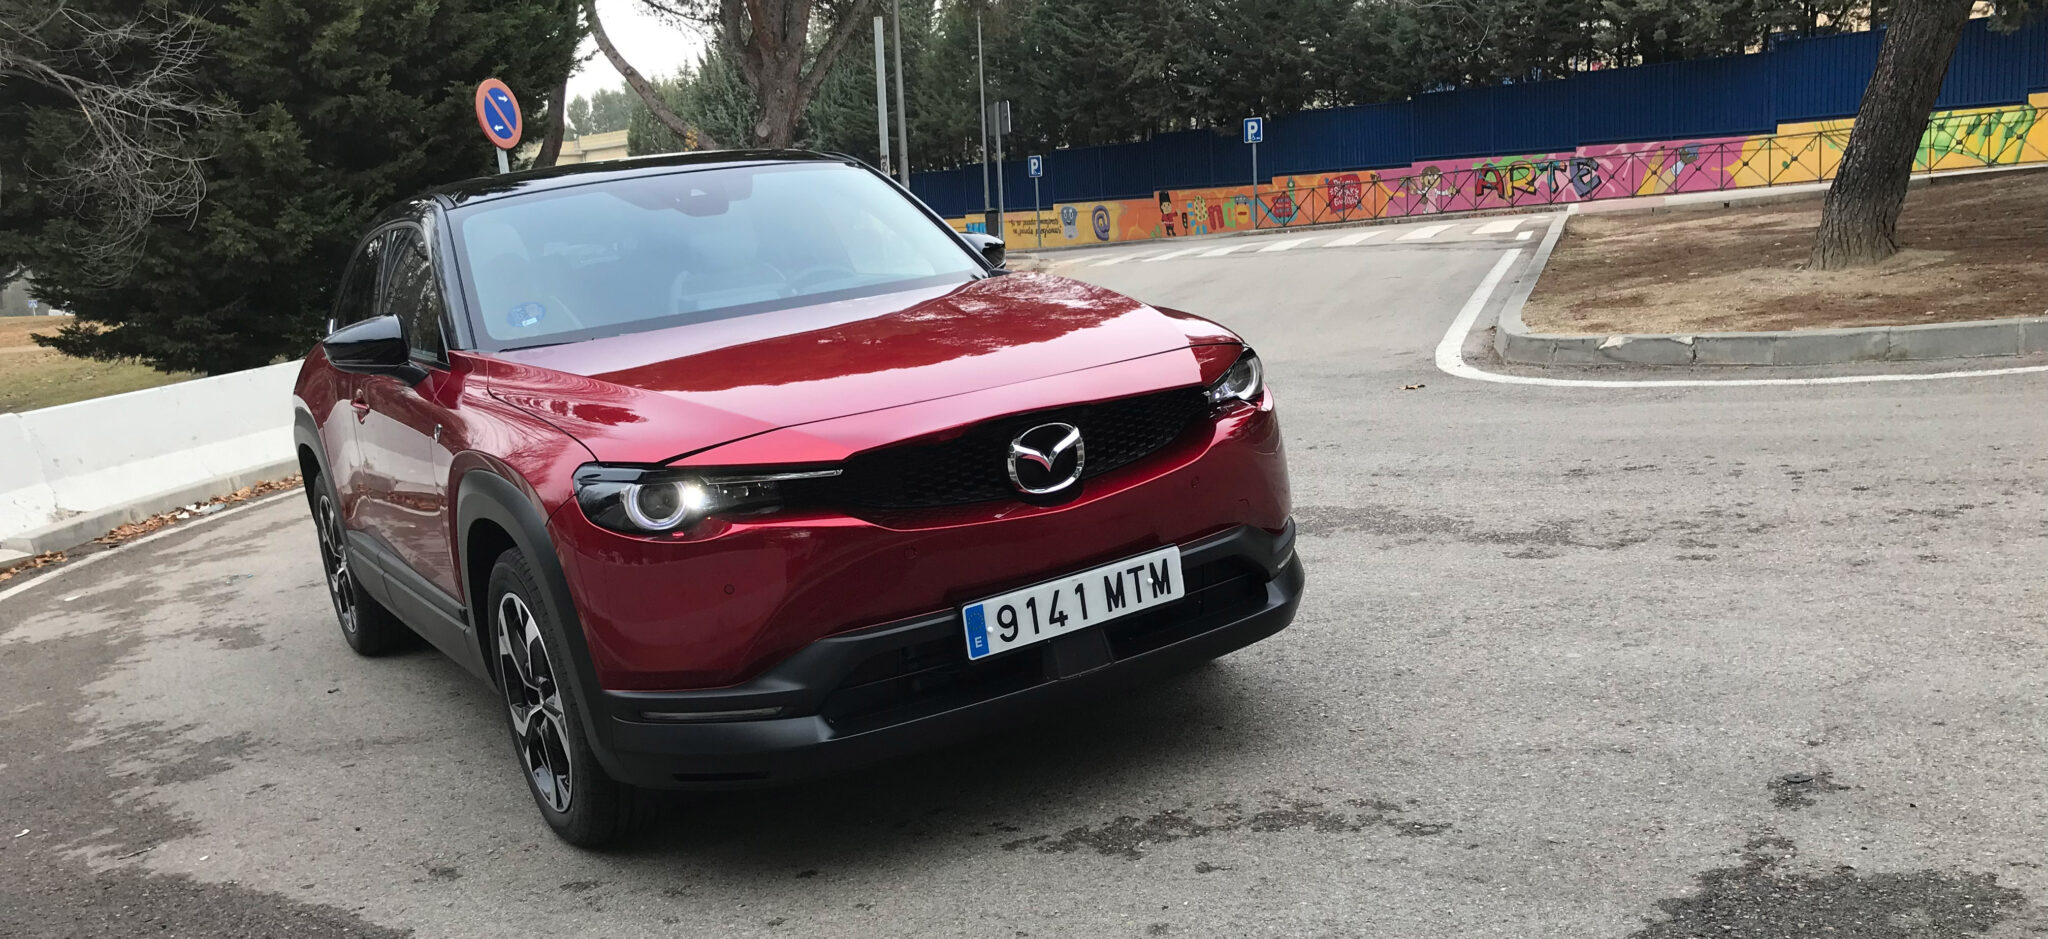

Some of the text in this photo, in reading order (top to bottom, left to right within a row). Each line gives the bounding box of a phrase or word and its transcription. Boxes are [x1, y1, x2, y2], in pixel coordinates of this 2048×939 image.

[1248, 121, 1259, 140] P
[1030, 158, 1039, 175] P
[1476, 157, 1602, 199] ARTE
[974, 558, 1172, 648] E 9141 MTM
